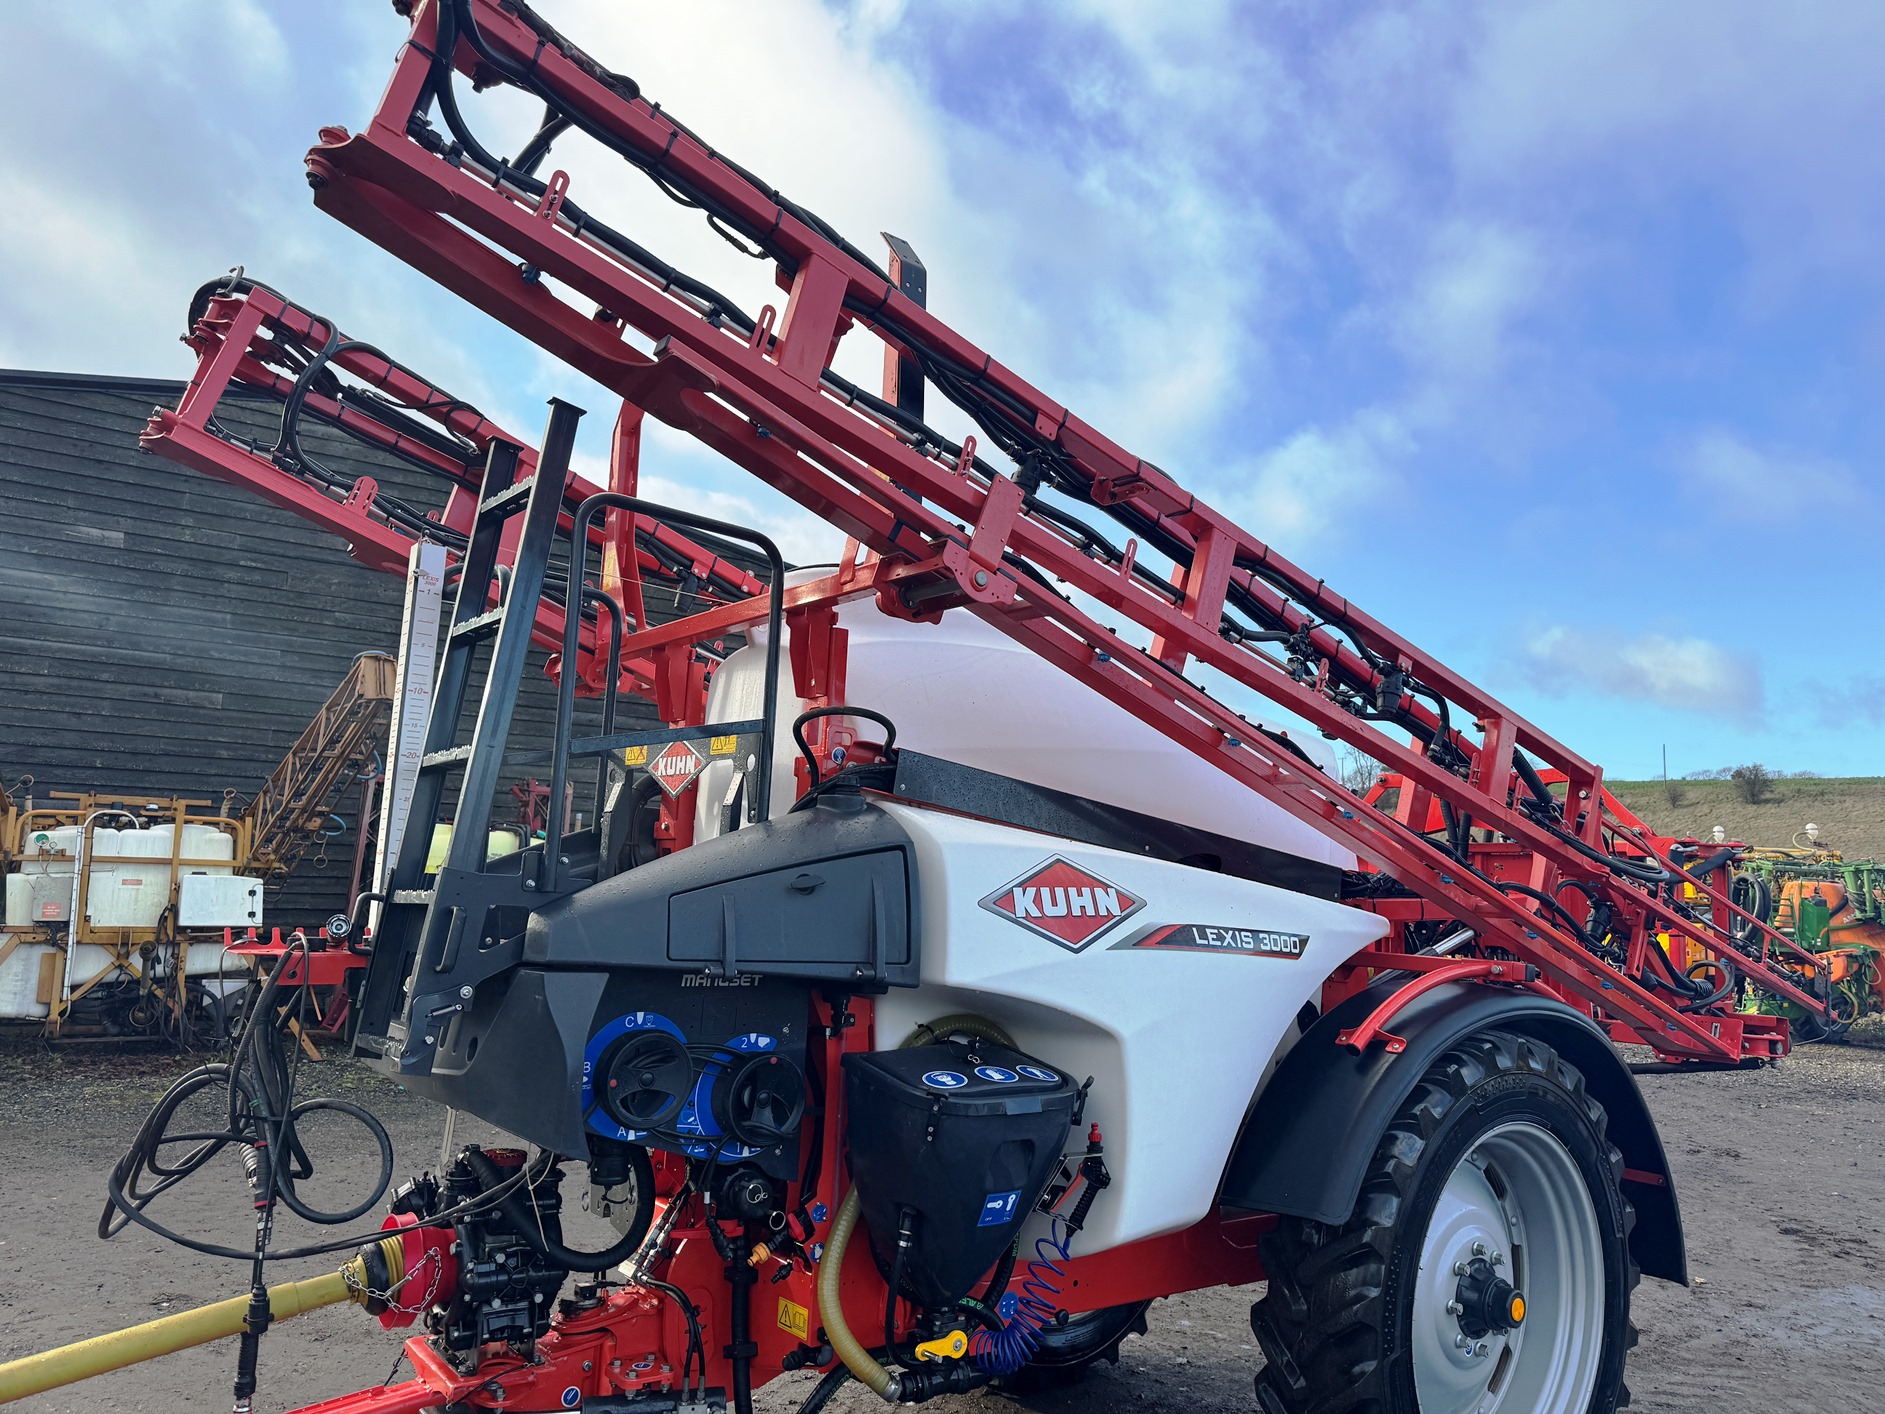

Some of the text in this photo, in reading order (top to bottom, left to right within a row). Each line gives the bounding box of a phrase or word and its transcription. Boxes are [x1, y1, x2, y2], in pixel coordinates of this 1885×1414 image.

[413, 687, 423, 695] 10
[658, 754, 696, 776] KUHN
[1012, 887, 1122, 918] KUHN
[1192, 926, 1300, 953] LEXIS 3000
[625, 1016, 634, 1028] C
[741, 1038, 748, 1048] 2
[583, 1061, 591, 1073] B
[617, 1126, 627, 1137] A
